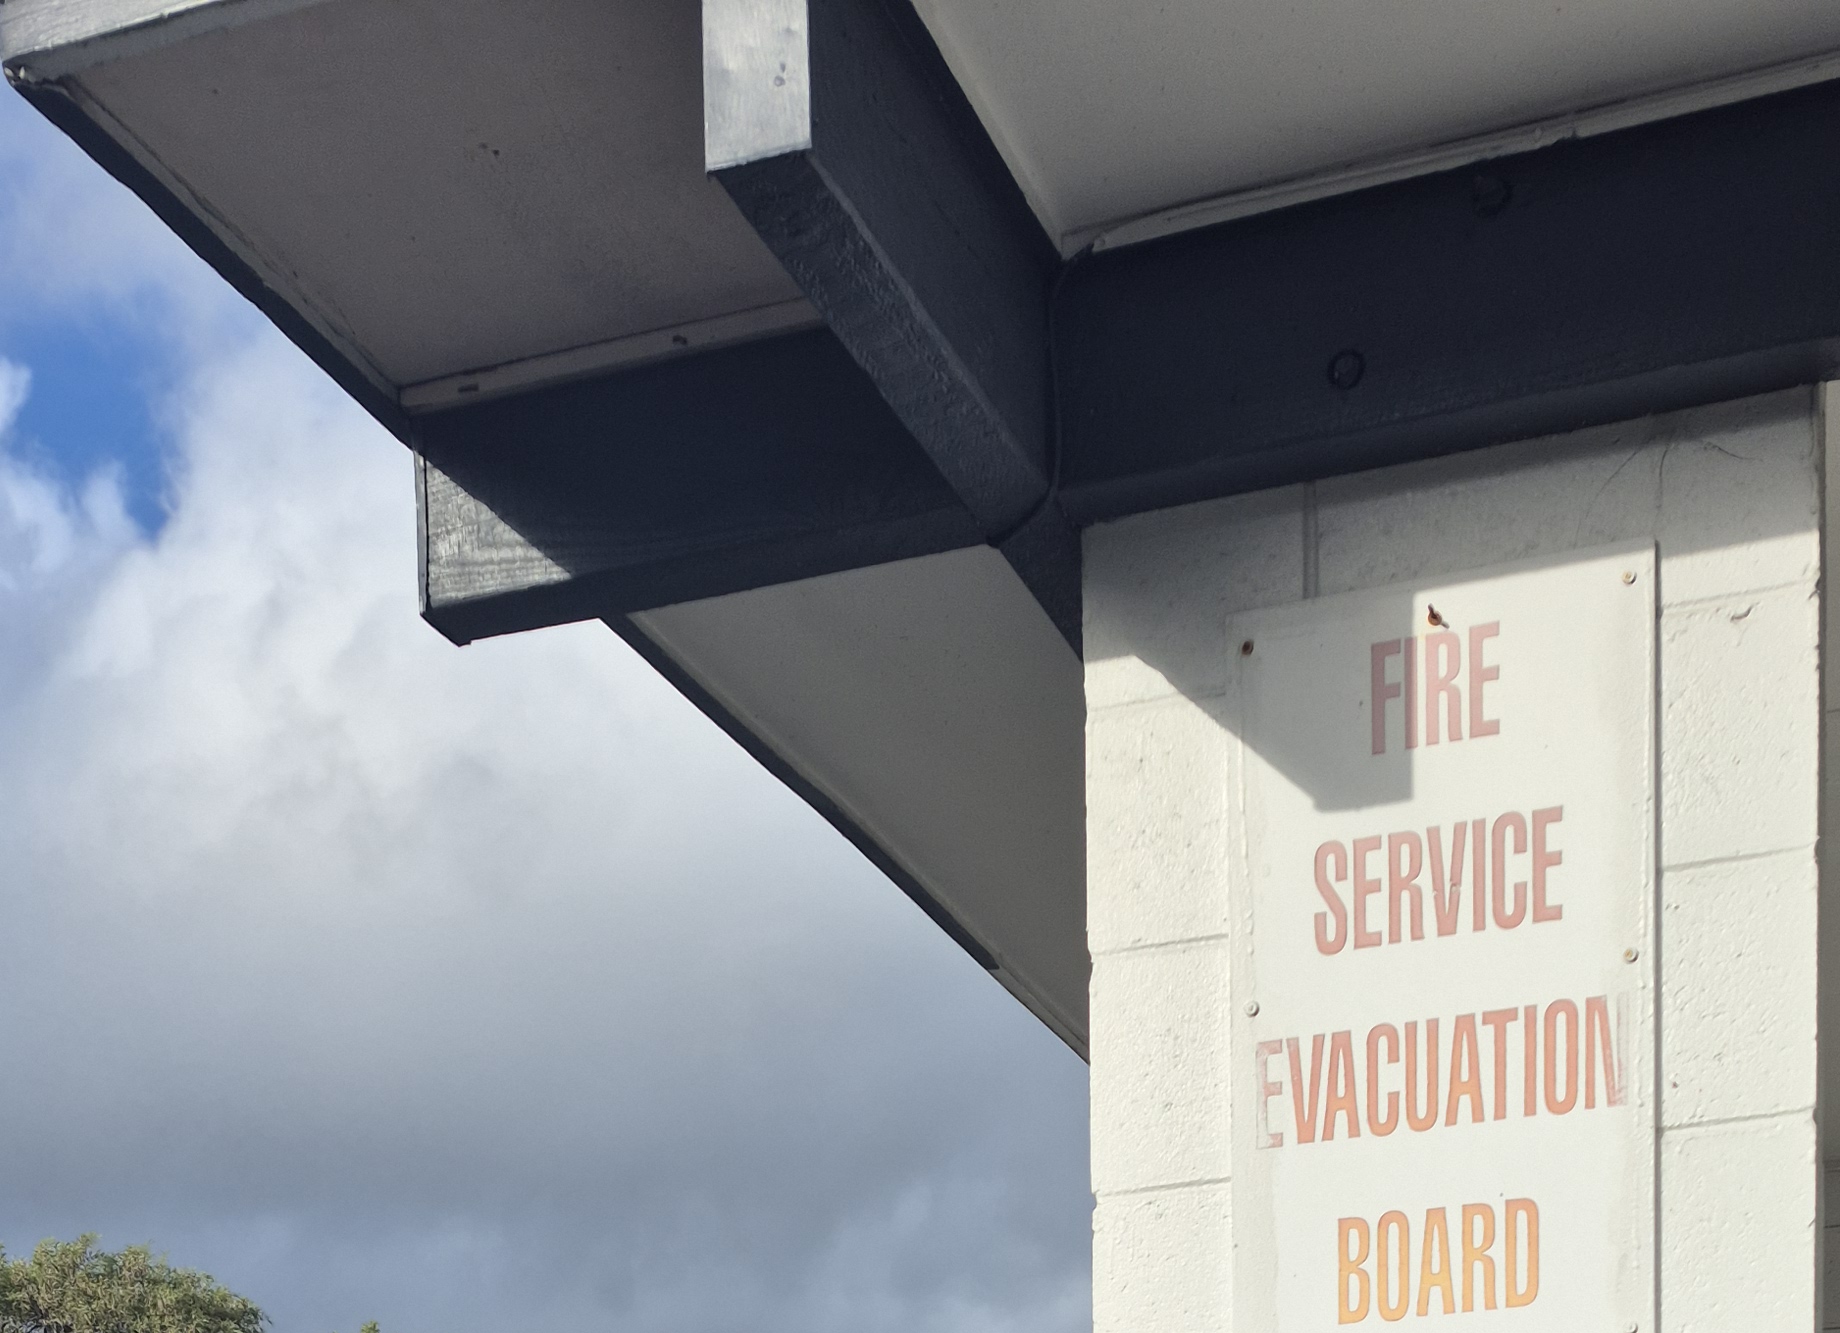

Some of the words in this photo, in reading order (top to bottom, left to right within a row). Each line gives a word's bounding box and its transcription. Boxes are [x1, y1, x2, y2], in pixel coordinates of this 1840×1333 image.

[1370, 621, 1501, 756] FIRE
[1313, 805, 1564, 956] SERVICE
[1255, 992, 1628, 1151] EVACUATION
[1337, 1197, 1540, 1326] BOARD
